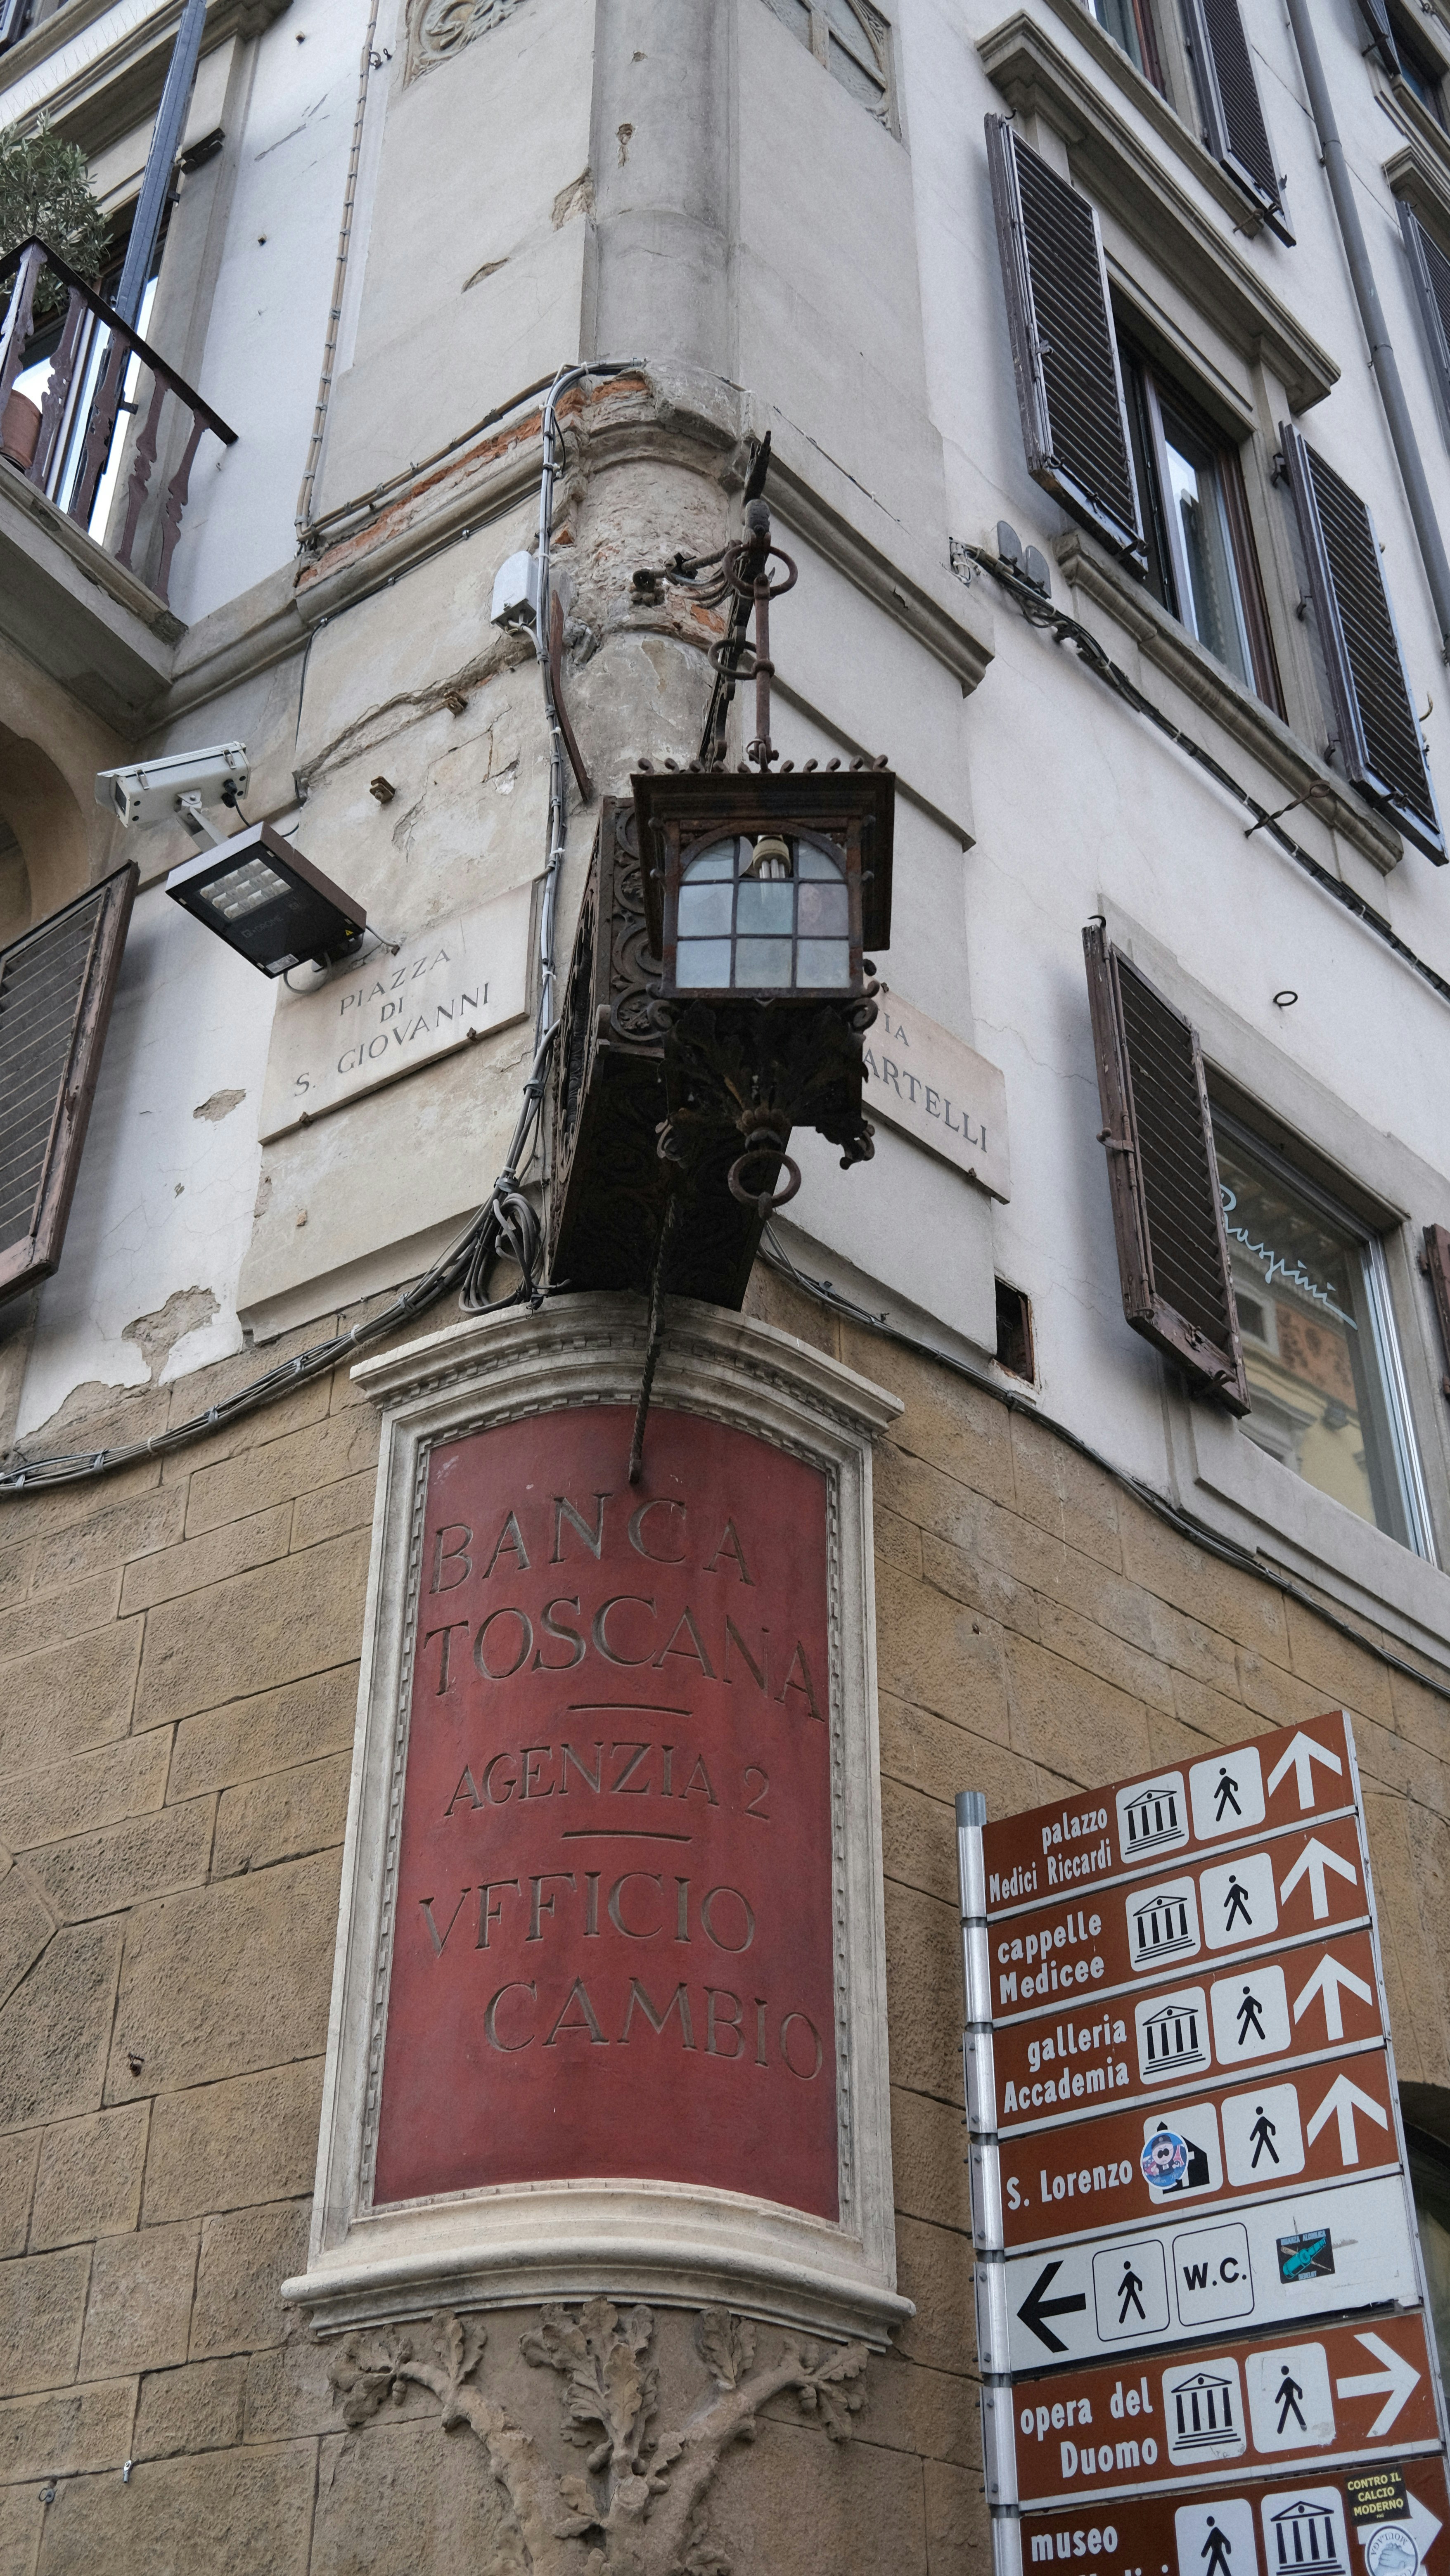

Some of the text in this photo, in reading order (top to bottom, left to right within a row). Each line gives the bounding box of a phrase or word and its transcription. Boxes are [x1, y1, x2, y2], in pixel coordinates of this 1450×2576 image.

[340, 949, 450, 1016] PIAZZA
[380, 997, 403, 1023] DI
[294, 983, 489, 1097] S. GIOVANNI
[884, 1012, 910, 1047] IA
[862, 1048, 987, 1153] ARTELLI
[429, 1492, 755, 1595] BANCA
[424, 1595, 825, 1724] TOSCANA
[443, 1741, 770, 1821] AGENZIA 2
[1042, 1808, 1108, 1854] palazzo
[989, 1838, 1112, 1904] Medici Riccardi
[997, 1911, 1102, 1968] cappelle
[999, 1954, 1104, 2005] Medicee
[483, 1975, 823, 2081] CAMBIO
[1027, 2014, 1128, 2072] galleria
[1003, 2057, 1130, 2114] Accademia
[1006, 2159, 1133, 2210] S. Lorenzo
[1183, 2256, 1247, 2291] W.C.
[1020, 2376, 1154, 2442] opera del
[1060, 2436, 1158, 2479] Duomo
[1347, 2472, 1402, 2491] CONTRO IL
[1353, 2498, 1404, 2517] MODERNO
[1358, 2486, 1395, 2502] CALCIO
[1031, 2526, 1118, 2562] museo
